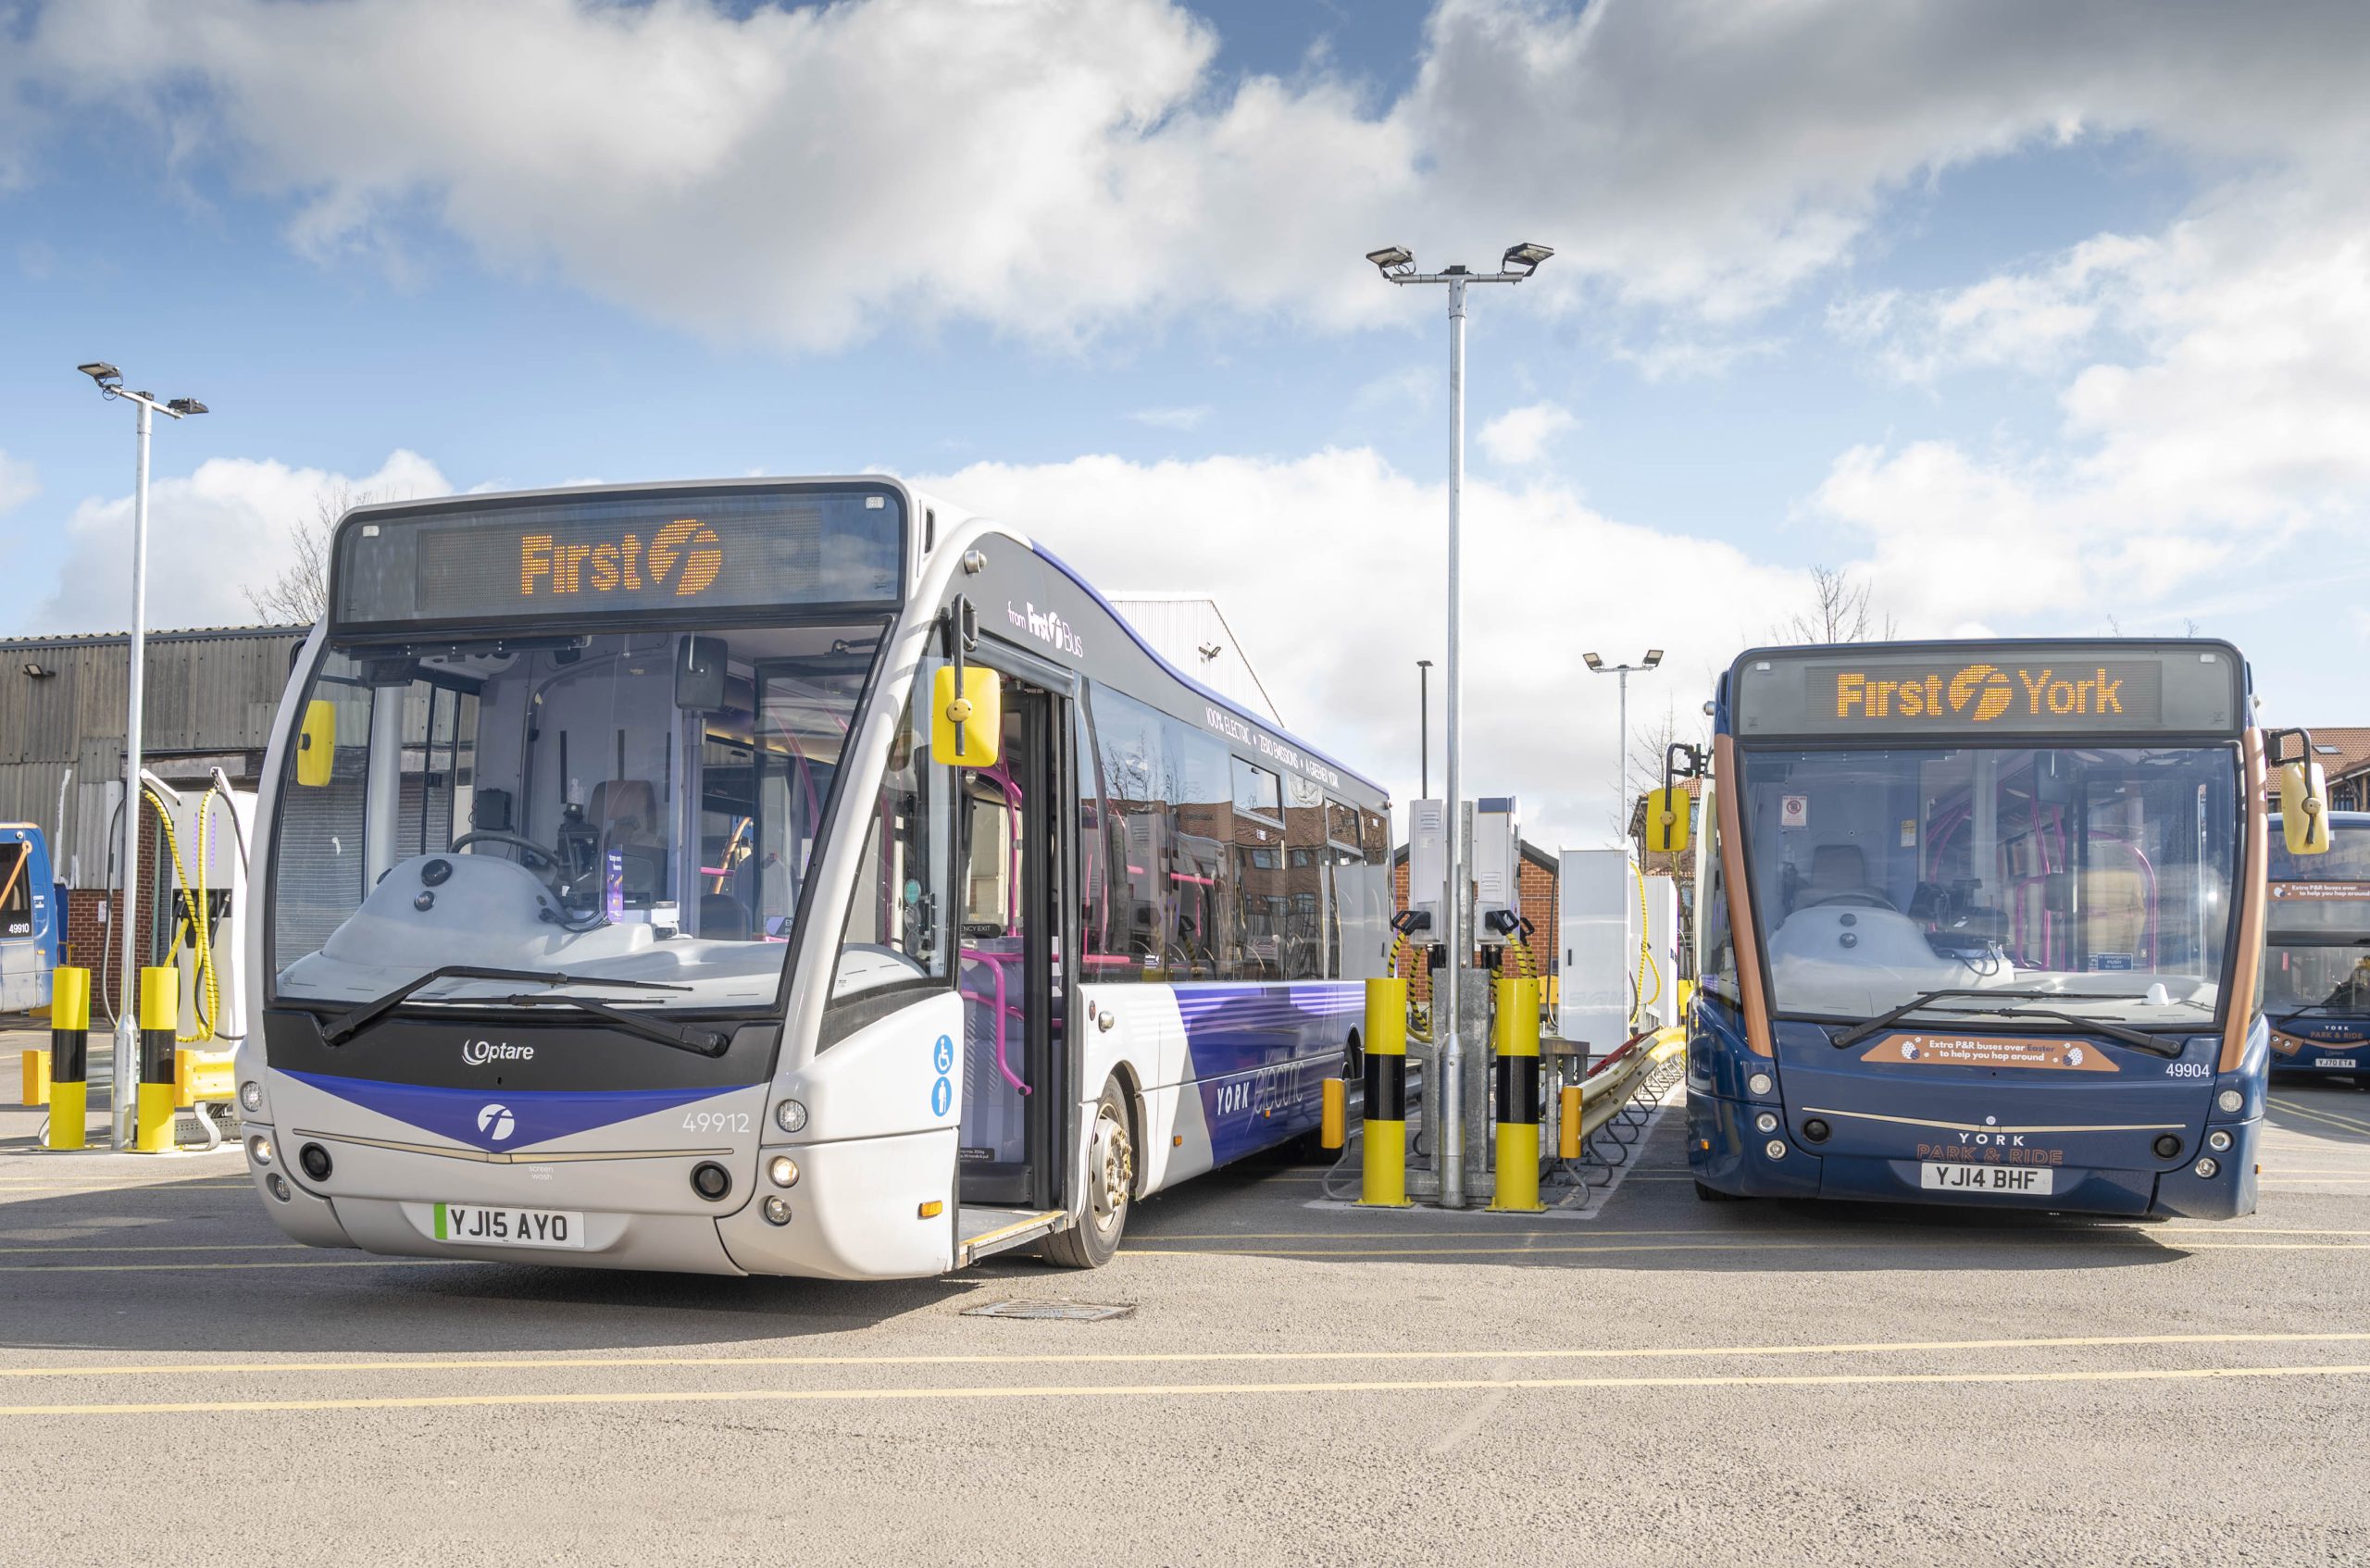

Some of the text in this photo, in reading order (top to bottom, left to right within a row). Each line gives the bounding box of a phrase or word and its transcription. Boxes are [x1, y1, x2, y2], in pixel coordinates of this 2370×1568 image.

[521, 534, 642, 595] First
[1007, 601, 1083, 658] from First Bus
[1837, 667, 2124, 717] First York
[1223, 715, 1252, 745] ELECTRIC
[8, 923, 30, 934] 49910
[475, 1040, 534, 1064] Optare
[1929, 1039, 2055, 1052] Extra P&R buses over Easter
[1951, 1050, 1971, 1060] help
[1991, 1051, 2010, 1061] hop
[2011, 1052, 2044, 1062] around
[2165, 1063, 2211, 1077] 49904
[1217, 1081, 1250, 1116] YORK
[681, 1113, 751, 1133] 49912
[1959, 1133, 2025, 1147] YORK
[1916, 1143, 2064, 1165] PARK & RIDE
[529, 1165, 555, 1174] screen
[1936, 1166, 2039, 1189] YJ14 BHF
[450, 1208, 568, 1241] YJ15 AYO
